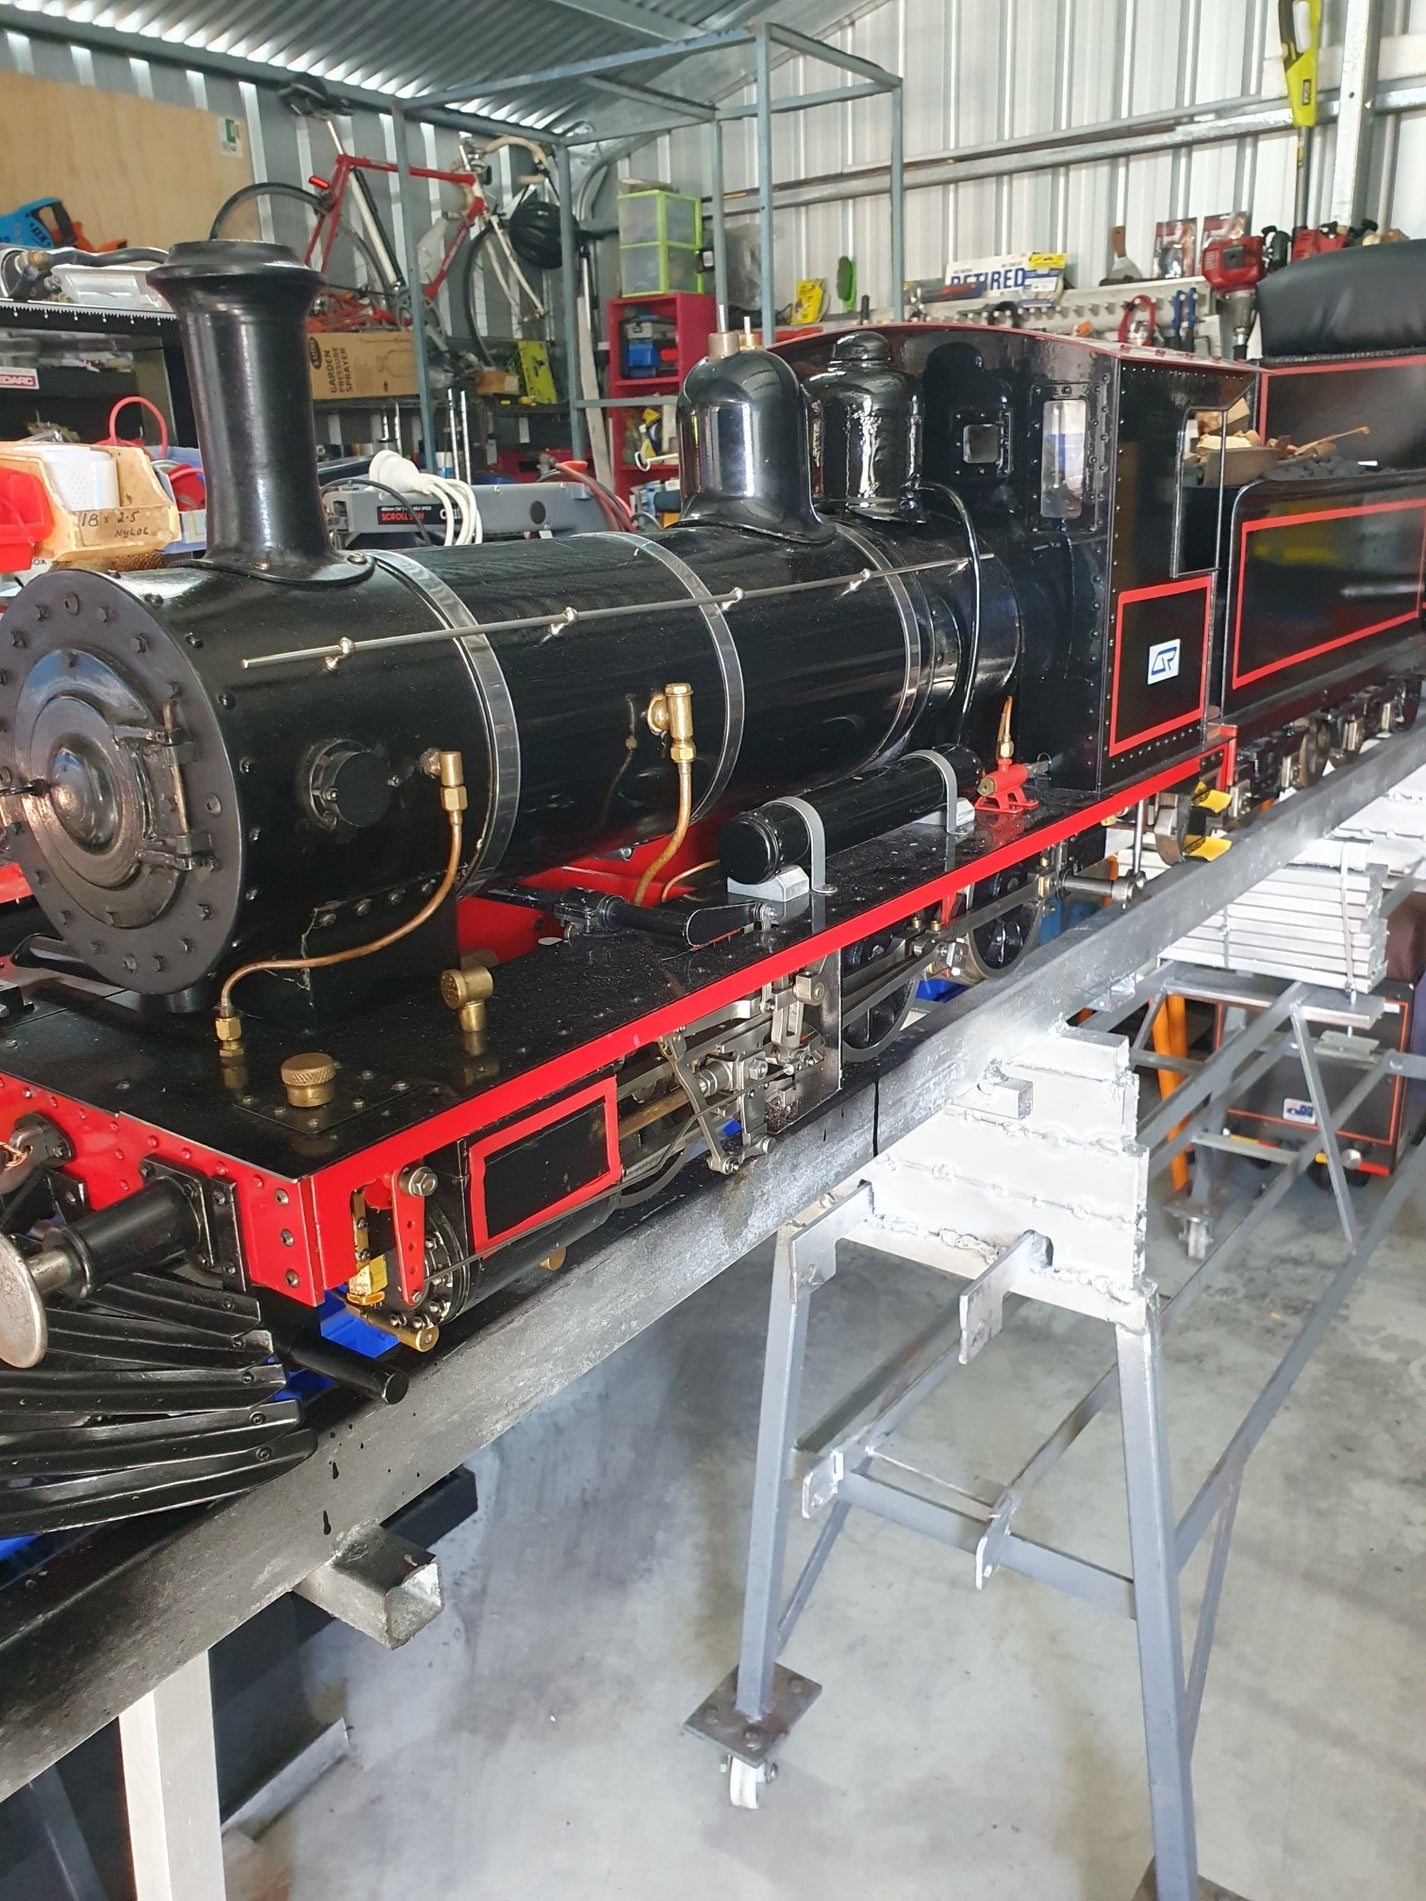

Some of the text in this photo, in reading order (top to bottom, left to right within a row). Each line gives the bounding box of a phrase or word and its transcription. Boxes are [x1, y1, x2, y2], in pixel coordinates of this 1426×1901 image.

[323, 350, 338, 393] GARDEN
[331, 346, 345, 393] PRESSURE
[339, 347, 354, 393] SPRAYER
[81, 513, 99, 527] 18
[381, 512, 409, 521] SCROLL
